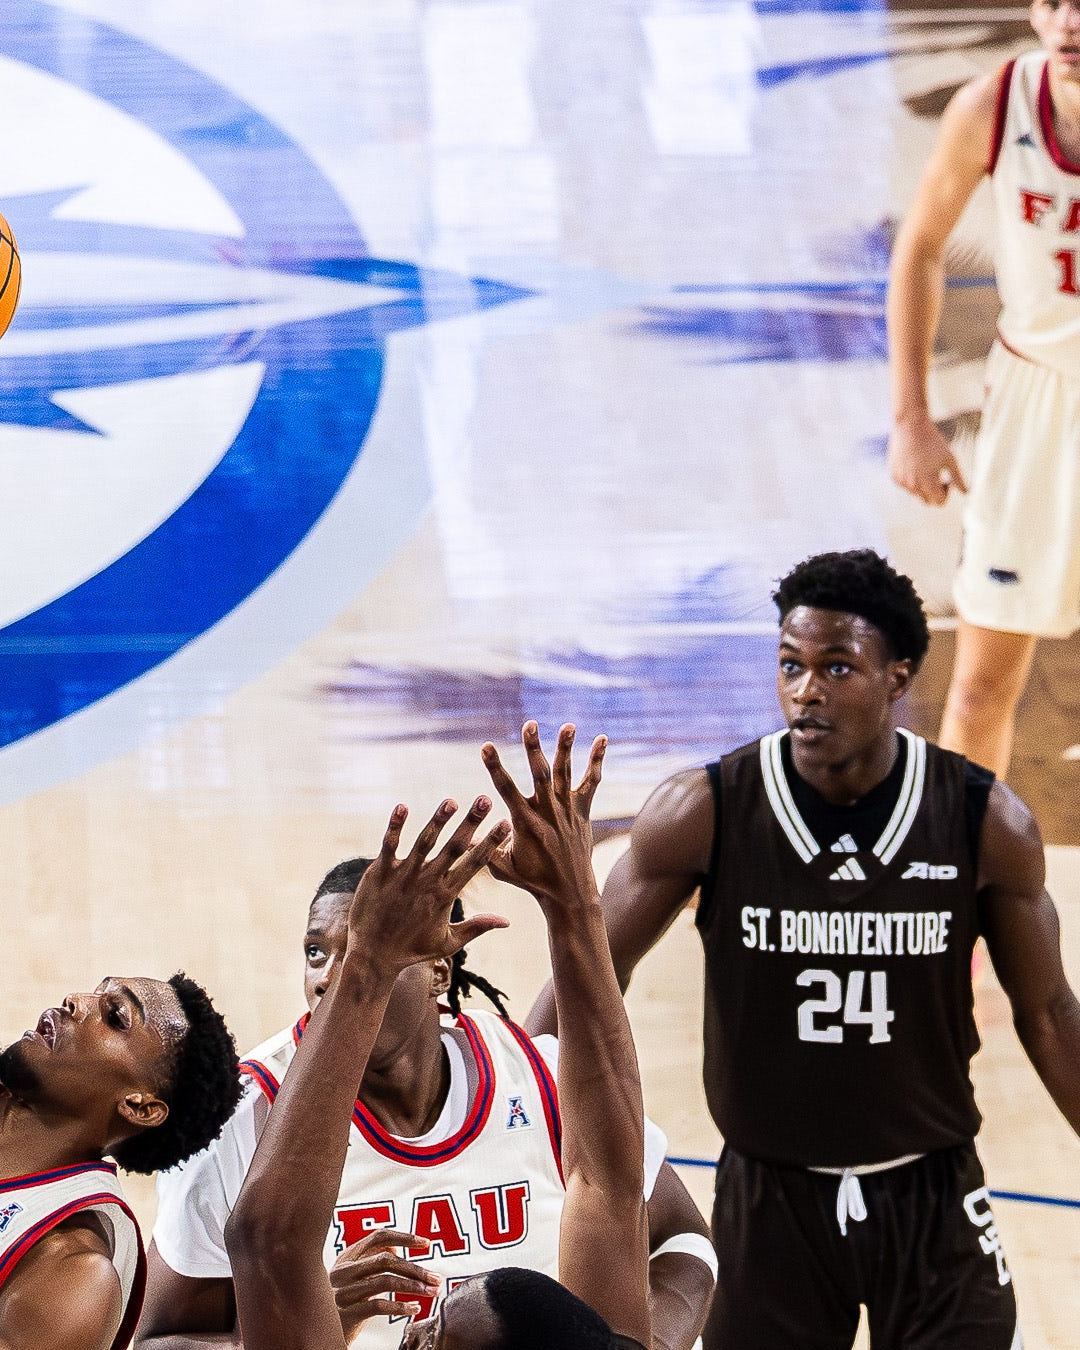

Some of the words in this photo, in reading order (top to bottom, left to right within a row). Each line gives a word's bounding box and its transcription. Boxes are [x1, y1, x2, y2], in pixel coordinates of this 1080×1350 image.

[741, 906, 775, 951] ST.
[780, 910, 952, 955] BONAVENTURE
[796, 968, 895, 1044] 24
